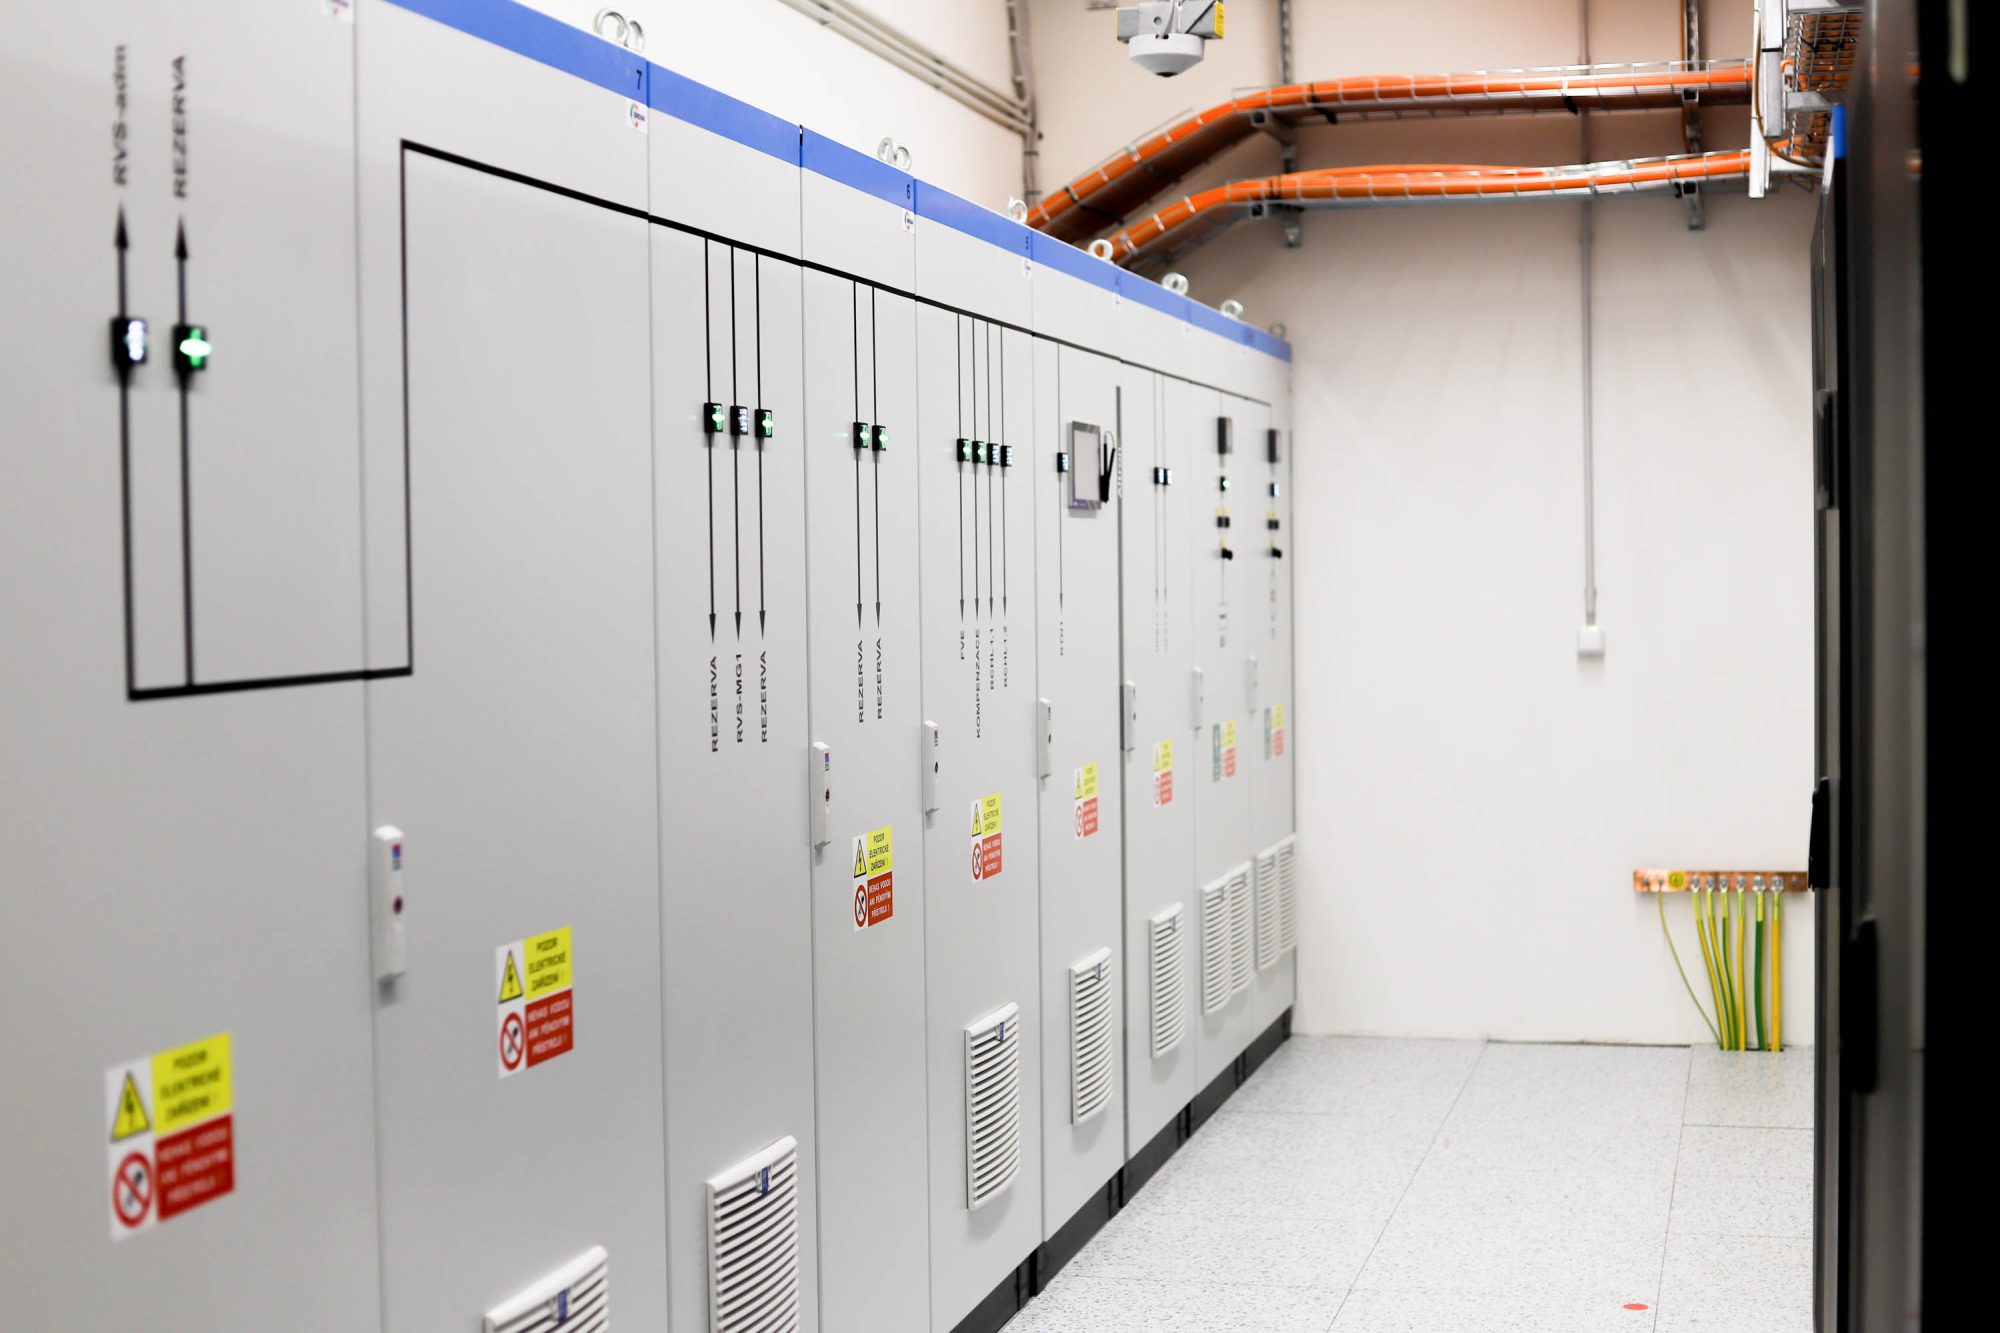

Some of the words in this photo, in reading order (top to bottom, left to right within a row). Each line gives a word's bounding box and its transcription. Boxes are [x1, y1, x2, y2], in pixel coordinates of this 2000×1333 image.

[112, 45, 129, 187] RVS-adm
[636, 69, 642, 91] 7
[171, 55, 188, 201] REZERVA
[709, 655, 719, 753] REZERVA
[735, 653, 744, 744] RVS-MG1
[759, 650, 768, 743] REZERVA
